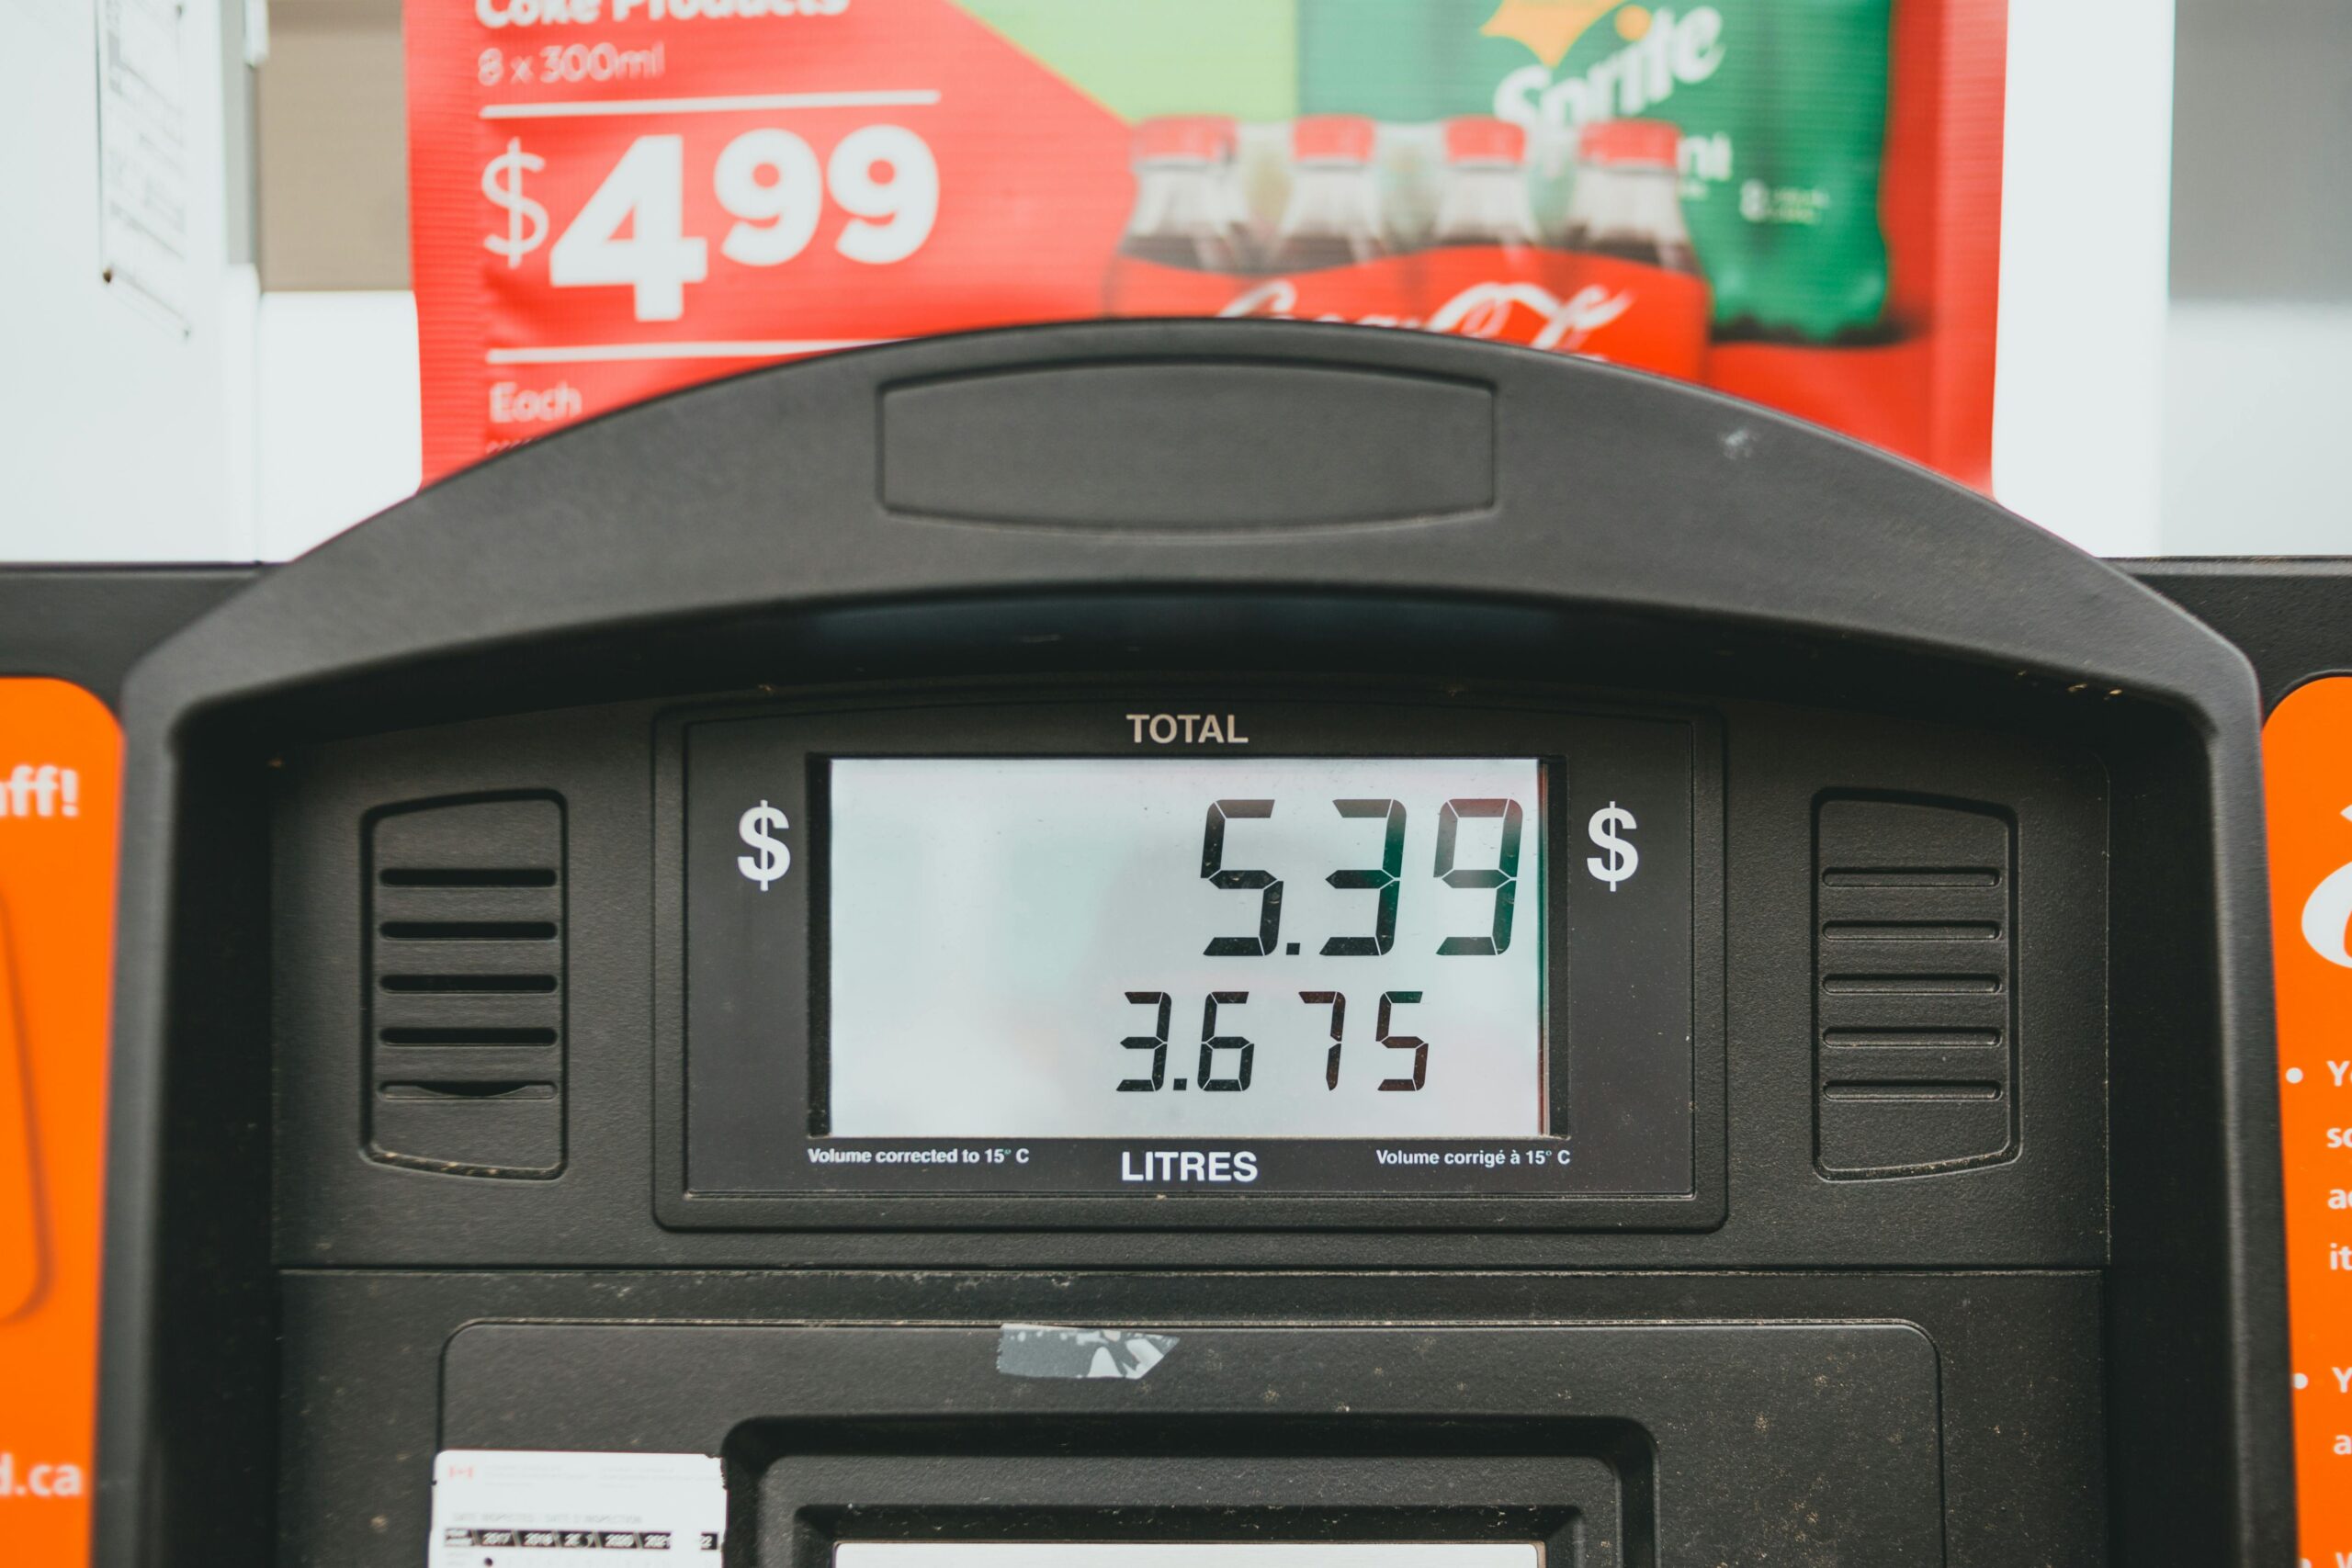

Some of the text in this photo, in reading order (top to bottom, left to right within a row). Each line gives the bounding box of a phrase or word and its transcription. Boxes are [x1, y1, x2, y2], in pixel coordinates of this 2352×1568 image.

[478, 41, 665, 86] 8 x 300ml
[489, 379, 582, 423] Each
[1125, 714, 1249, 744] TOTAL
[0, 764, 79, 818] ff!
[737, 799, 791, 892] $
[1586, 801, 1639, 892] $
[1200, 798, 1523, 957] 5.39
[1115, 991, 1429, 1092] 3.675
[807, 1148, 872, 1164] Volume
[875, 1148, 958, 1164] corrected
[963, 1148, 980, 1164] to
[1015, 1148, 1030, 1164] C
[1122, 1150, 1259, 1182] LITRES
[1375, 1149, 1440, 1165] Volume
[1443, 1148, 1506, 1168] corrigé
[1510, 1148, 1521, 1165] à
[1557, 1149, 1571, 1165] C
